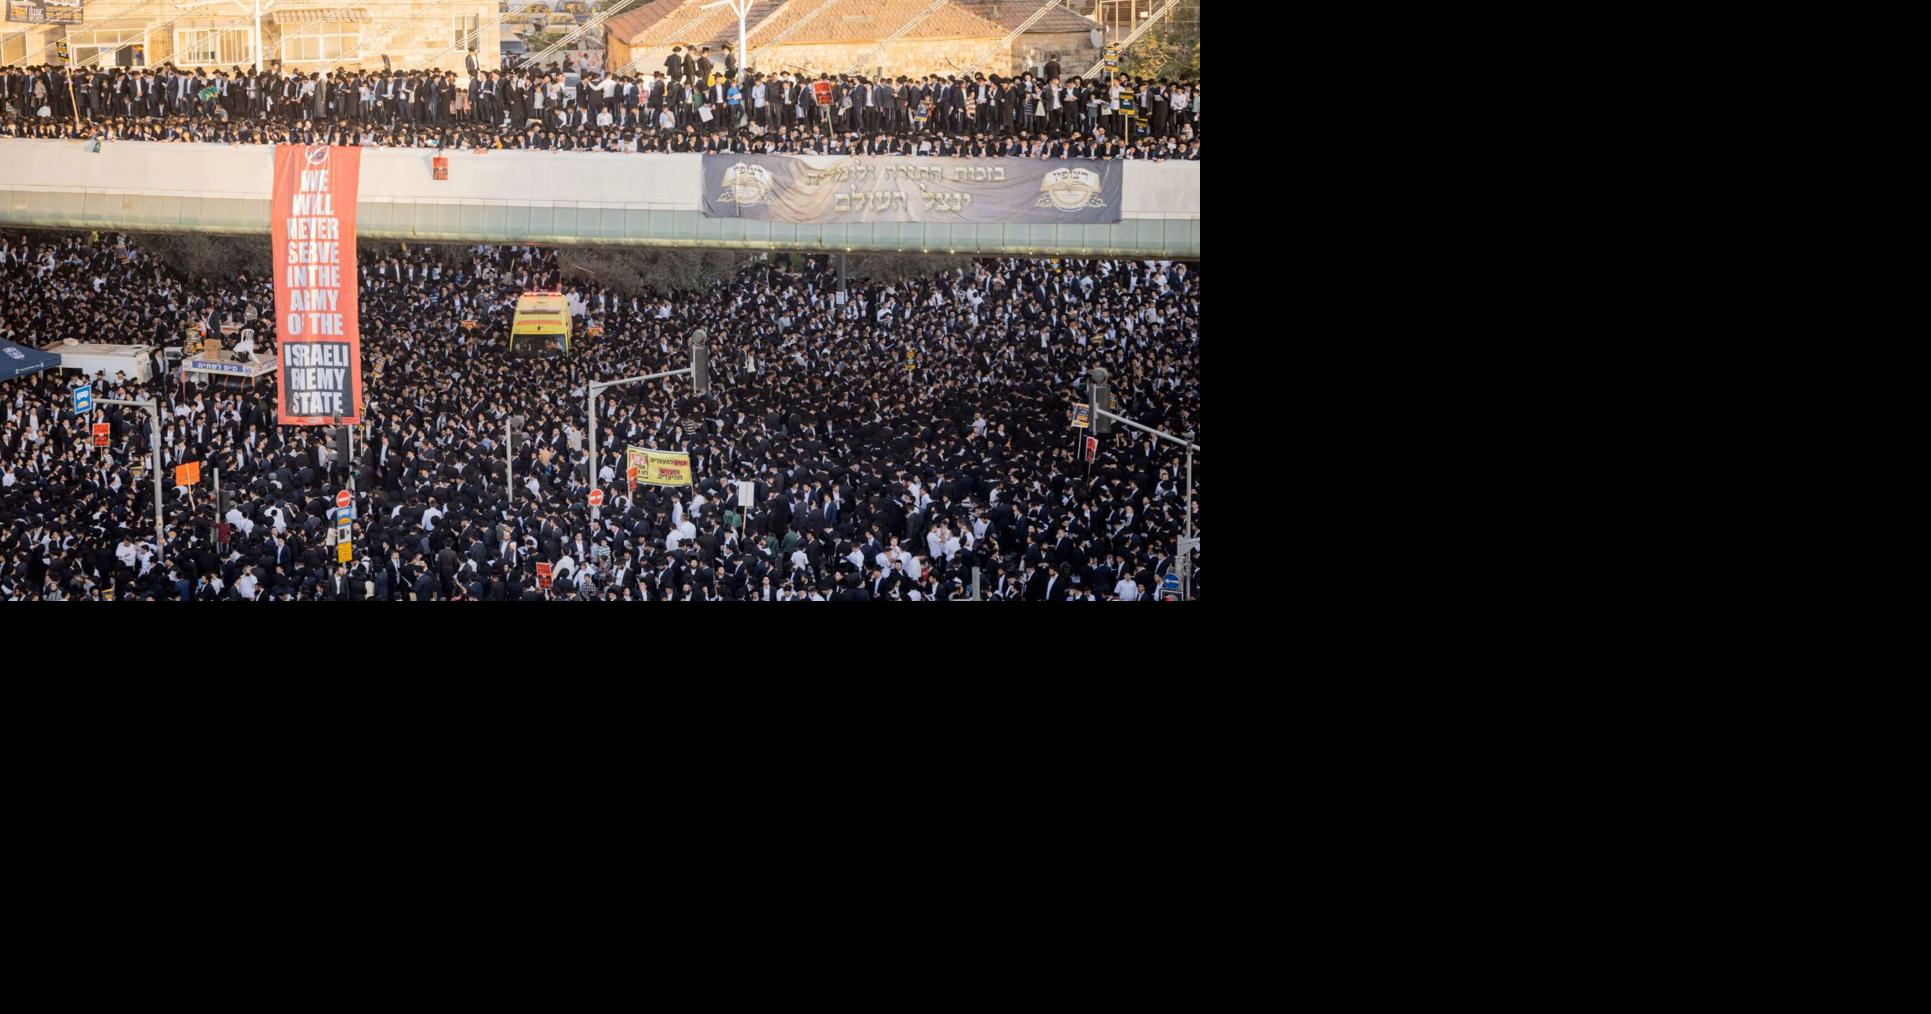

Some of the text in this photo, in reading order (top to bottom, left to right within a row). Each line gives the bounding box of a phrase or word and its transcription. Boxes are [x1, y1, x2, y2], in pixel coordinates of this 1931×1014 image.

[301, 169, 329, 192] WE
[954, 165, 1007, 182] בזכות
[292, 193, 334, 215] WILL
[834, 183, 973, 212] ינצל העולם
[286, 217, 340, 240] NEVER
[287, 241, 340, 263] SERVE
[289, 288, 339, 311] ARMY
[287, 312, 344, 335] O THE
[284, 344, 349, 366] ISRAELI
[292, 391, 344, 414] STATE
